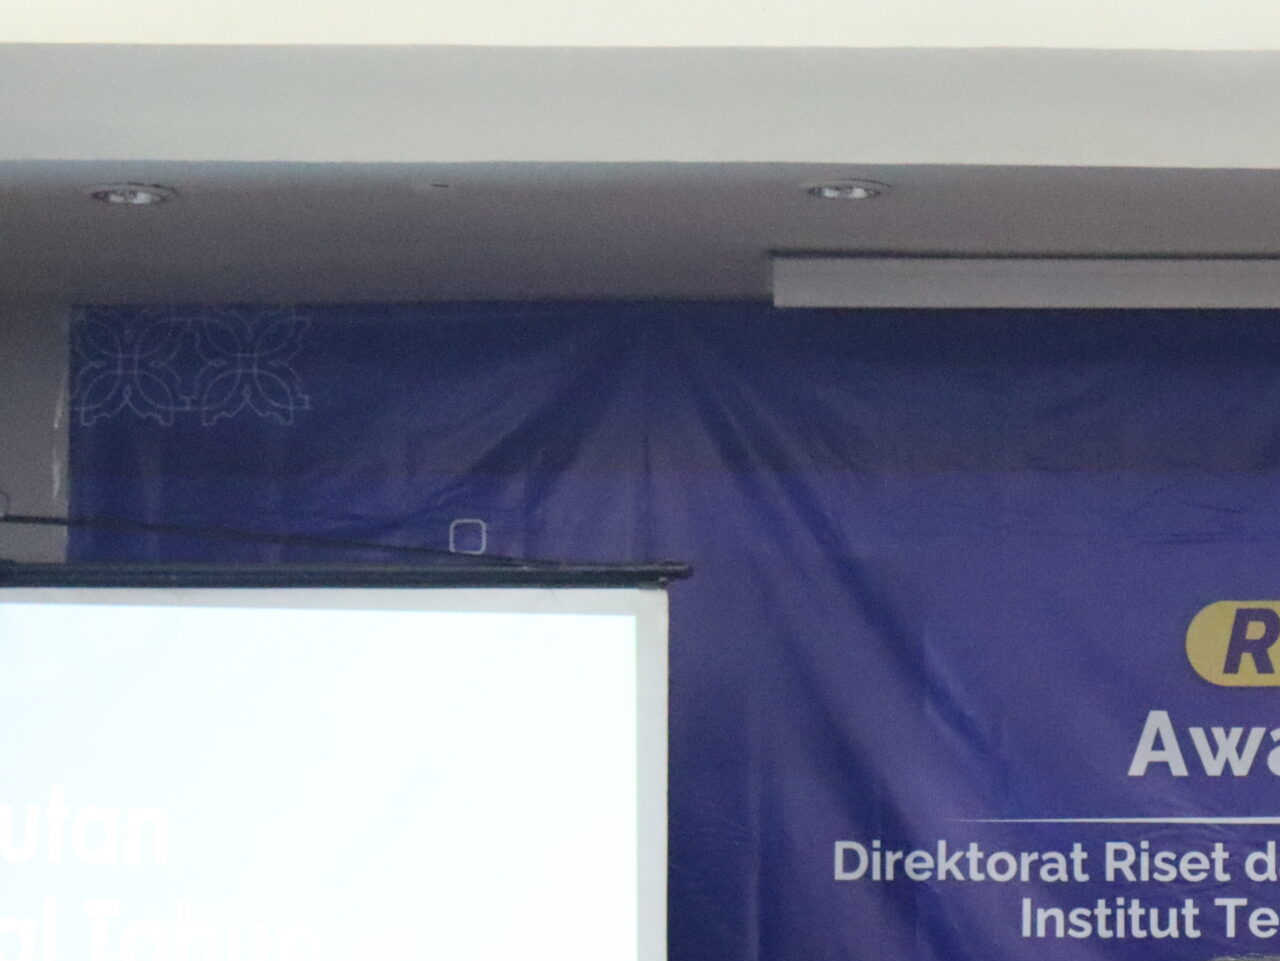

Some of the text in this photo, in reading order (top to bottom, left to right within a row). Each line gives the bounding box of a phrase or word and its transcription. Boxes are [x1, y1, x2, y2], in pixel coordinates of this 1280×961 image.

[834, 839, 1090, 882] Direktorat
[1105, 840, 1231, 882] Riset
[1022, 897, 1201, 939] Institut
